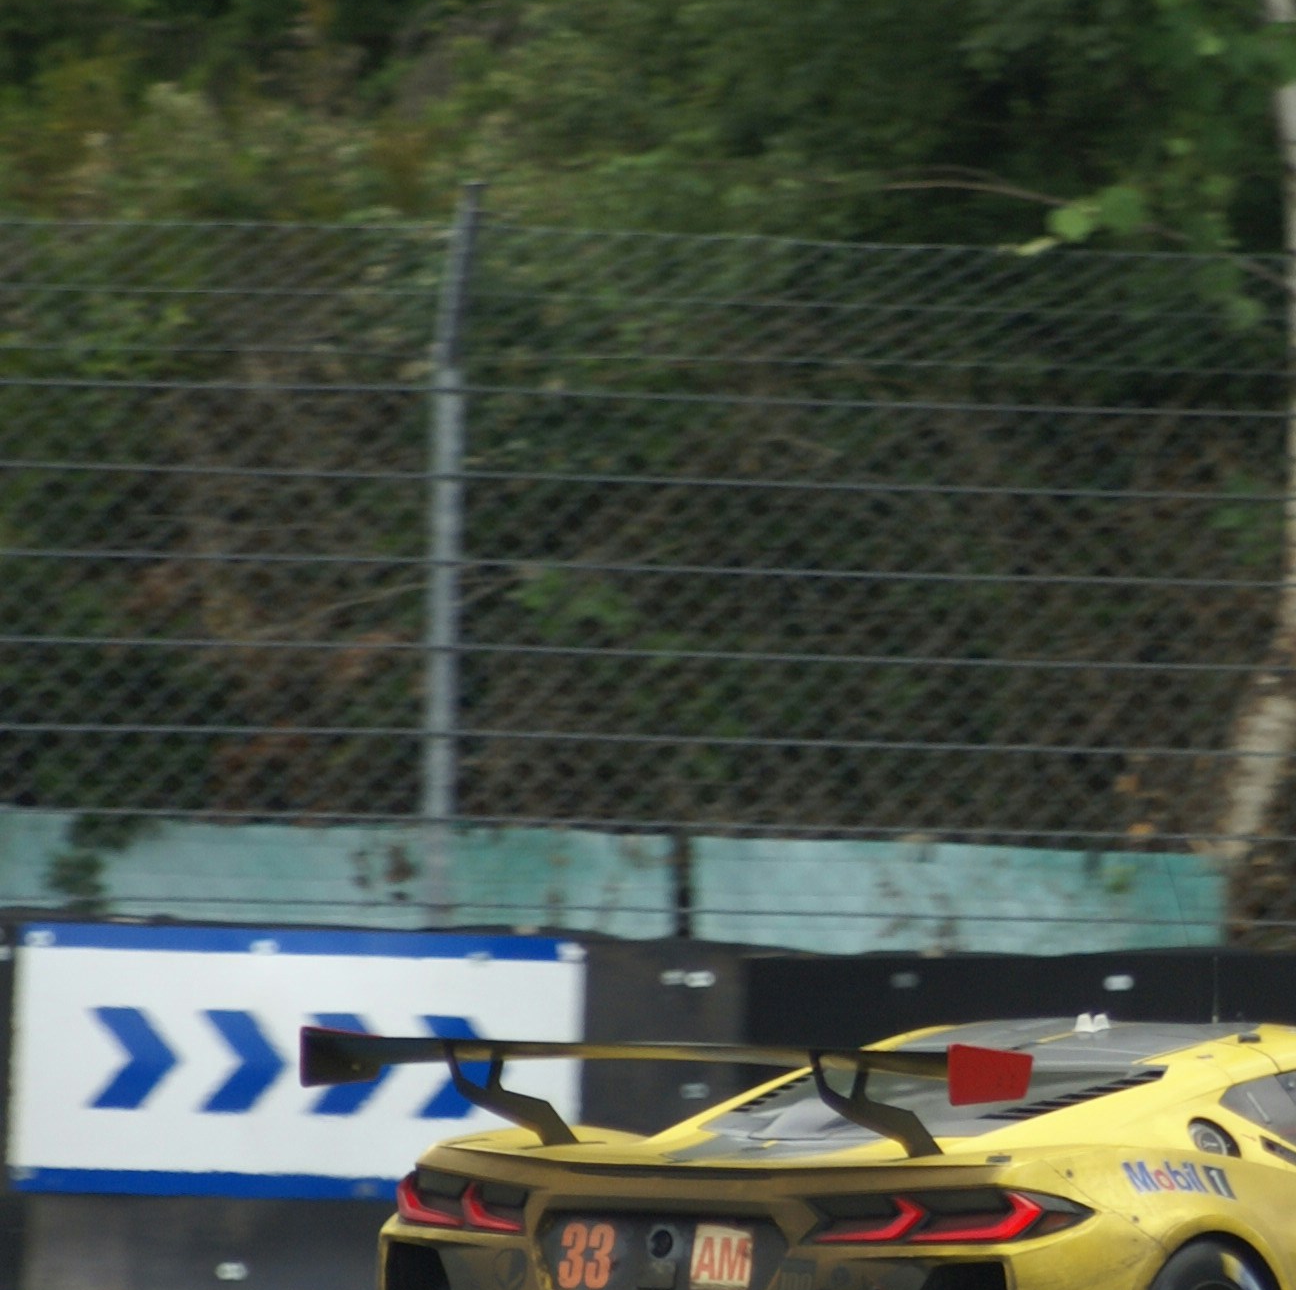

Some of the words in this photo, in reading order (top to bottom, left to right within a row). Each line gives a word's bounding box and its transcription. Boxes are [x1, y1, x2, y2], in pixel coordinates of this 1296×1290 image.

[1121, 1159, 1208, 1193] Mobil
[1207, 1168, 1232, 1198] 1
[557, 1222, 616, 1290] 33
[691, 1235, 751, 1282] AM
